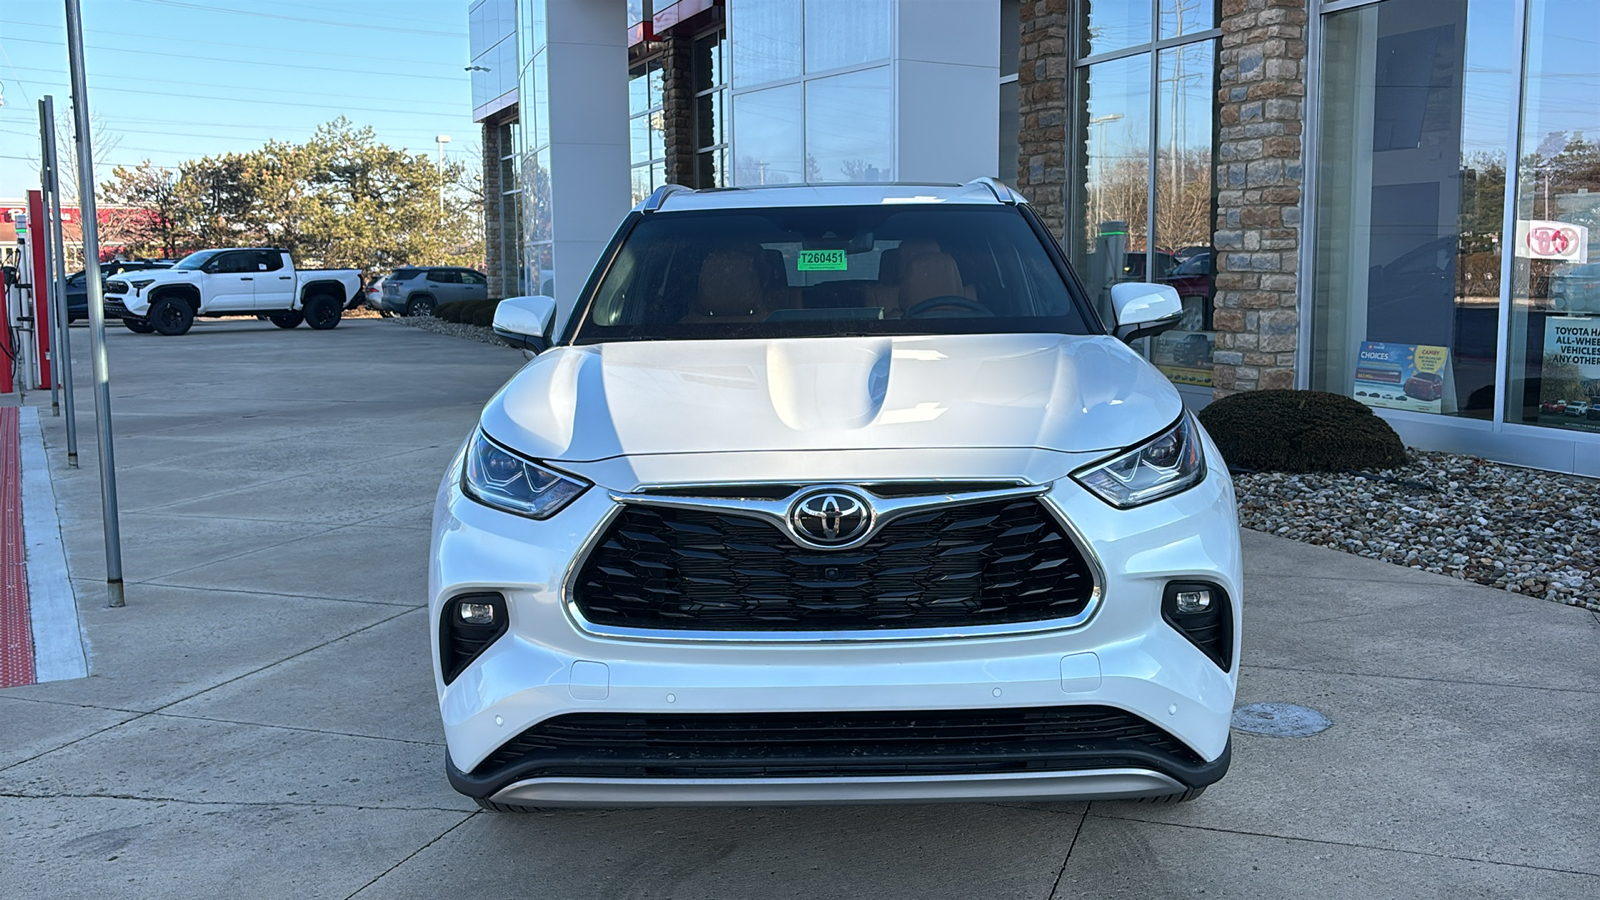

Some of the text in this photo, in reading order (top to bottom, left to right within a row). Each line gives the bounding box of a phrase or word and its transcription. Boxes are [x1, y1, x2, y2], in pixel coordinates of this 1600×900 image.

[801, 253, 843, 263] T260451
[1555, 326, 1589, 336] TOYOTA
[1556, 336, 1600, 347] ALL-WHEE
[1360, 351, 1389, 360] CHOICES
[1561, 345, 1600, 356] VEHICLES
[1552, 354, 1600, 366] ANY OTHER
